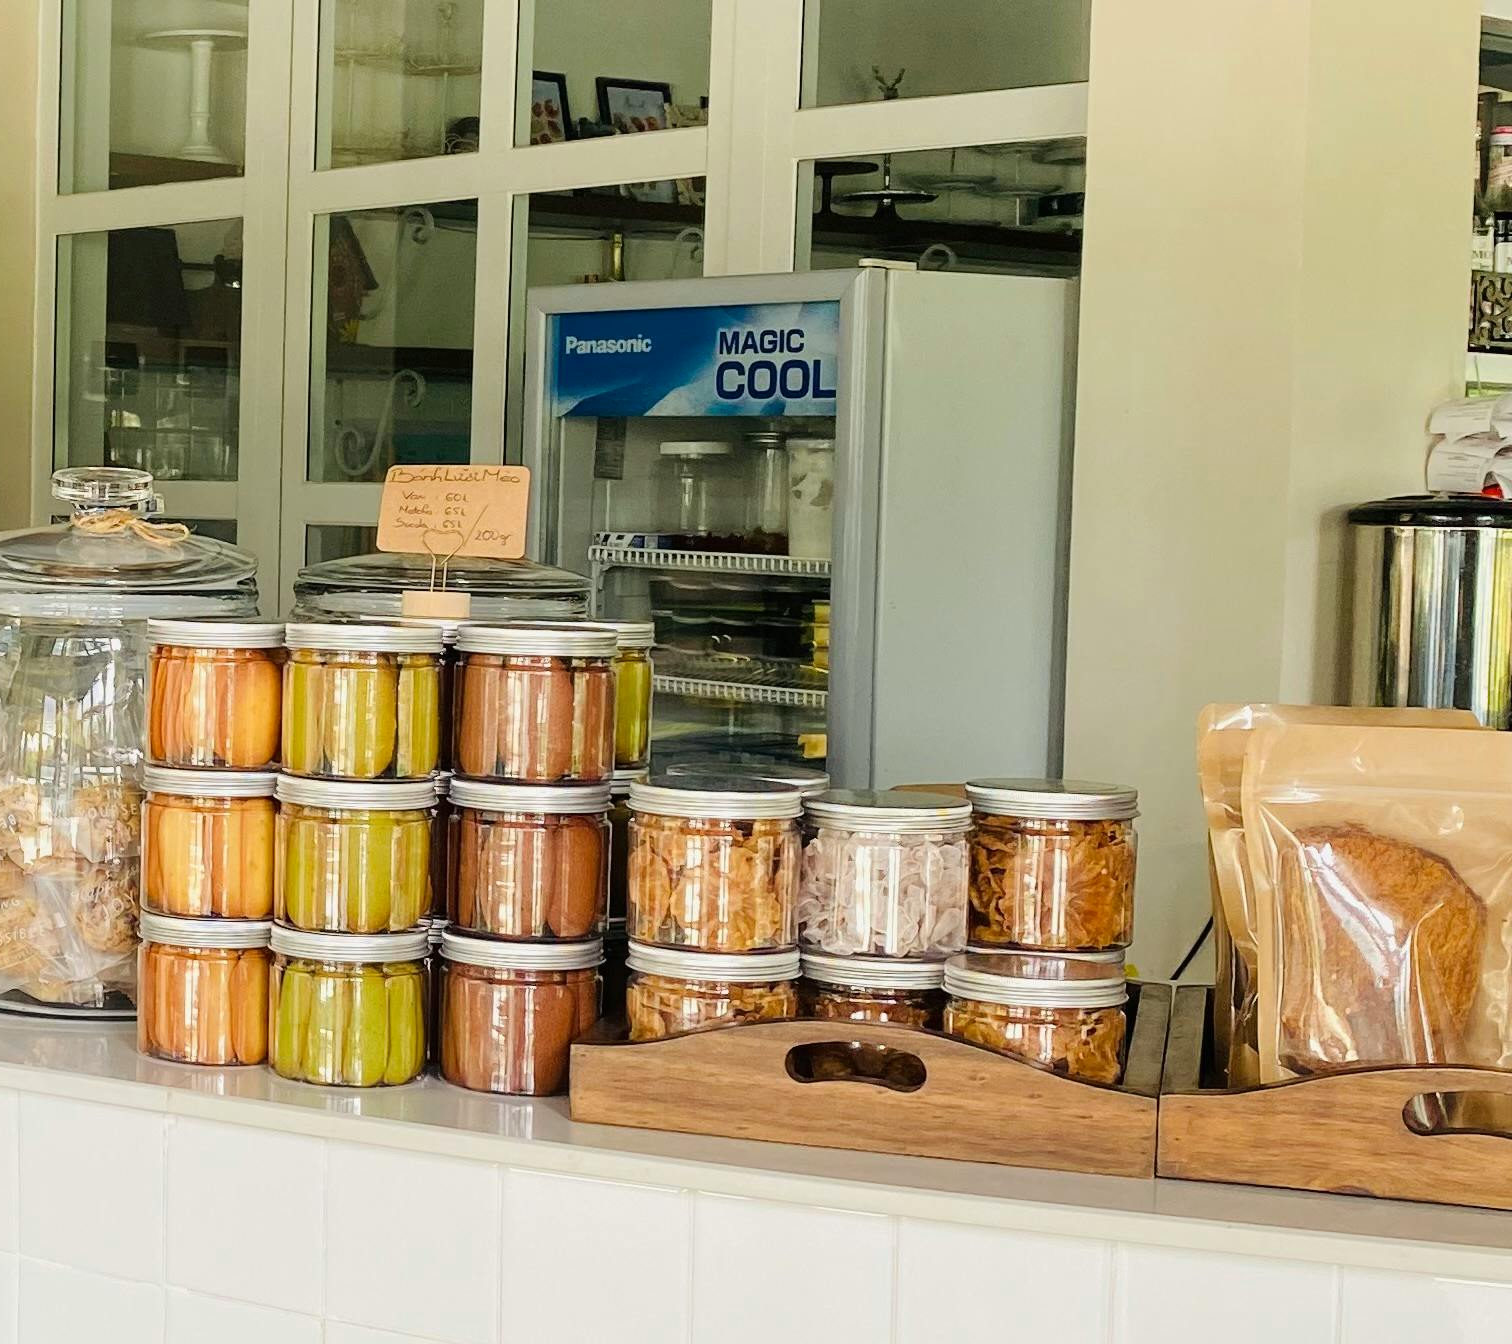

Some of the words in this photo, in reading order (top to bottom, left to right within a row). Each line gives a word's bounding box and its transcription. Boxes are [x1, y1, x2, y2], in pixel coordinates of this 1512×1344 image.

[565, 334, 653, 355] Panasonic
[719, 328, 805, 355] MAGIC
[715, 359, 837, 400] COOL
